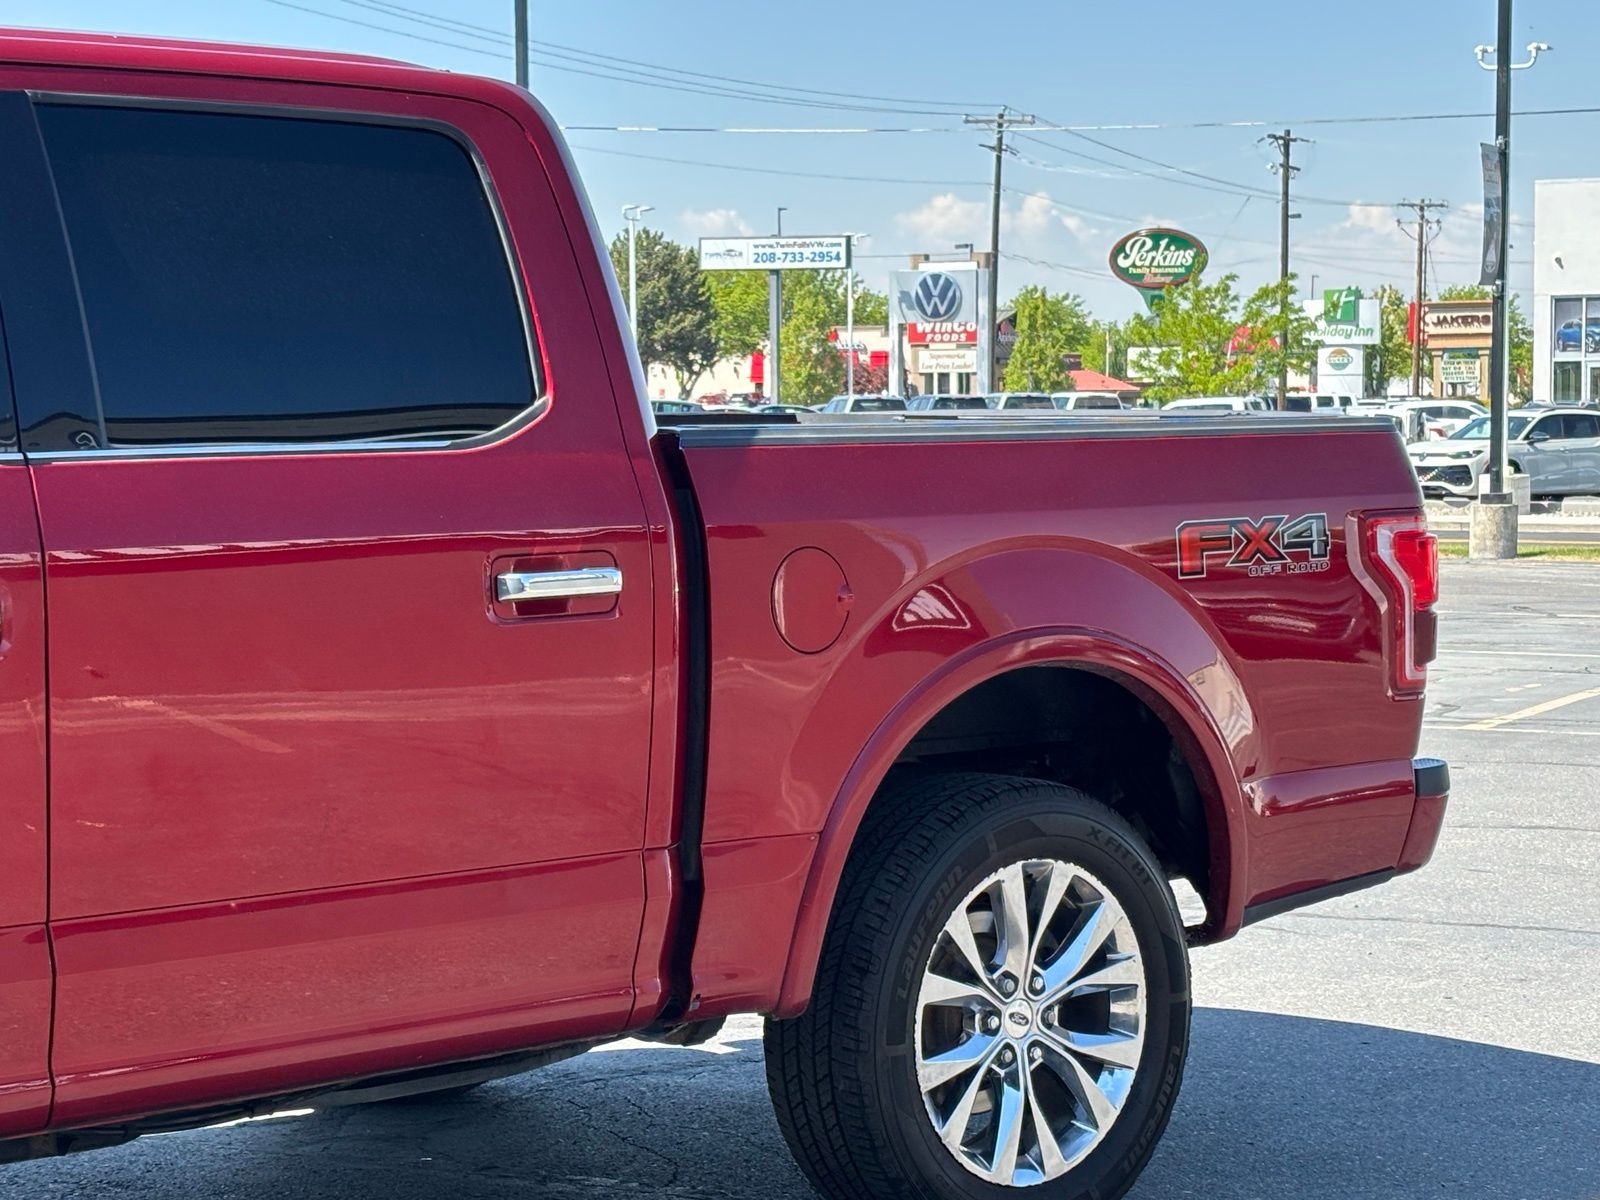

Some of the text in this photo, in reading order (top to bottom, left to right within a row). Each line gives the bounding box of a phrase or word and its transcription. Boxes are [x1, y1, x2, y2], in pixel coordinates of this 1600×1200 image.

[753, 241, 842, 249] www.TwinFallsVW.com
[1117, 236, 1194, 268] Perkins
[753, 251, 842, 263] 208-733-2954
[926, 333, 967, 342] FOODS
[1175, 512, 1331, 579] FX4
[1247, 561, 1330, 577] OFF ROAD
